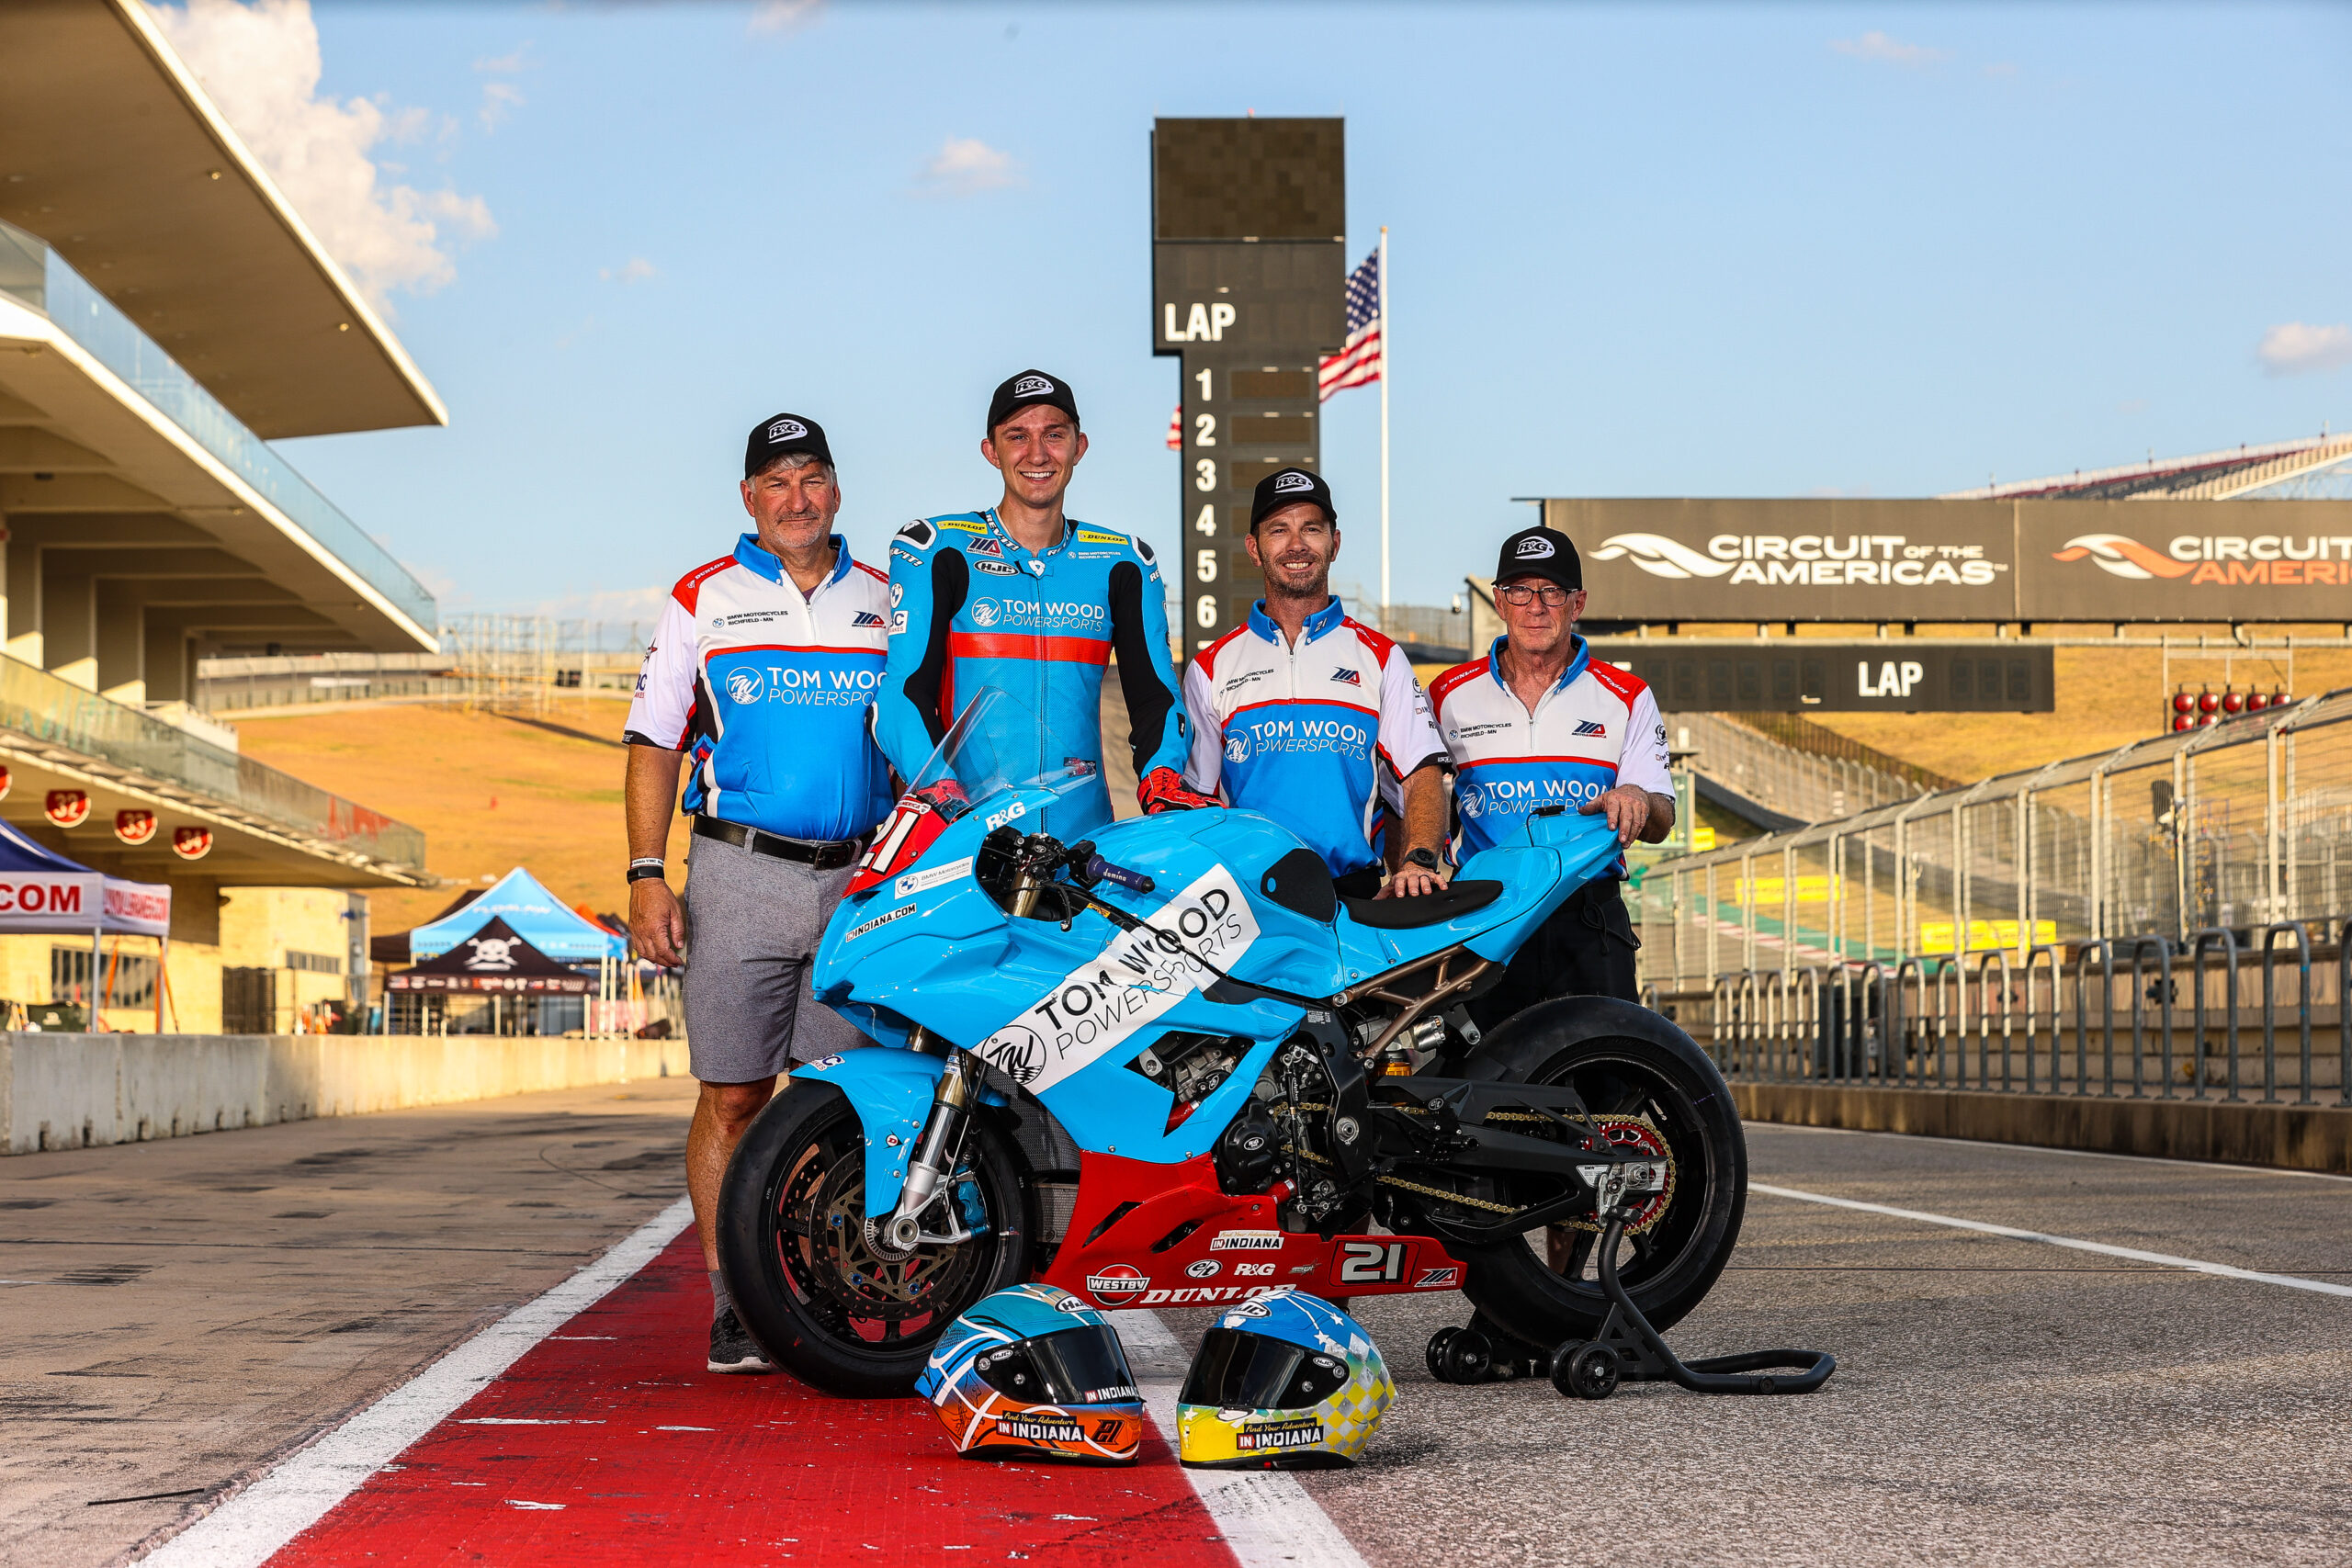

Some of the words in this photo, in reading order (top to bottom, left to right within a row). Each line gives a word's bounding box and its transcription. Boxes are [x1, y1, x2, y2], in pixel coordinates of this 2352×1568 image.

[1165, 303, 1236, 342] LAP
[1016, 380, 1046, 393] R&G
[1195, 368, 1212, 401] 1
[770, 423, 800, 439] R&G
[1195, 414, 1216, 446] 2
[1196, 459, 1216, 492] 3
[1277, 477, 1307, 489] R&G
[1196, 504, 1216, 537] 4
[1087, 534, 1125, 542] DUNLOP
[1517, 541, 1549, 554] R&G
[1707, 535, 1905, 560] CIRCUIT
[1904, 546, 1934, 559] OF
[1938, 546, 1983, 559] THE
[695, 561, 726, 580] DUNLOP
[980, 563, 1012, 573] HJC
[1197, 549, 1217, 582] 5
[2190, 561, 2352, 585] AMERI
[1002, 599, 1040, 615] TOM
[1045, 602, 1104, 619] WOOD
[1197, 595, 1216, 628] 6
[1002, 614, 1103, 632] POWERSPORTS
[1315, 616, 1328, 632] 21
[766, 667, 821, 688] TOM
[1449, 667, 1480, 683] DUNLOP
[1858, 661, 1924, 697] LAP
[1250, 720, 1294, 741] TOM
[1302, 720, 1367, 745] WOOD
[1472, 722, 1512, 730] MOTORCYCLES
[1485, 780, 1535, 799] TOM
[985, 801, 1026, 832] R&G
[1103, 868, 1126, 882] domina
[854, 904, 916, 936] INDIANA.COM
[1118, 888, 1230, 975] WOOD
[1056, 913, 1241, 1060] POWERSPORTS
[1214, 1240, 1223, 1248] IN
[1225, 1238, 1280, 1248] INDIANA
[1233, 1263, 1276, 1276] R&G
[1341, 1243, 1404, 1282] 21
[1091, 1278, 1146, 1291] WESTBY
[992, 1351, 1012, 1359] HJC
[1004, 1412, 1020, 1421] Find
[1021, 1415, 1036, 1423] Your
[1038, 1416, 1074, 1425] Adventure
[1264, 1424, 1280, 1432] Your
[1282, 1421, 1315, 1430] Adventure
[999, 1422, 1010, 1433] IN
[1013, 1422, 1082, 1440] INDIANA
[1093, 1420, 1124, 1445] 21
[1239, 1436, 1252, 1447] IN
[1256, 1427, 1321, 1449] INDIANA
